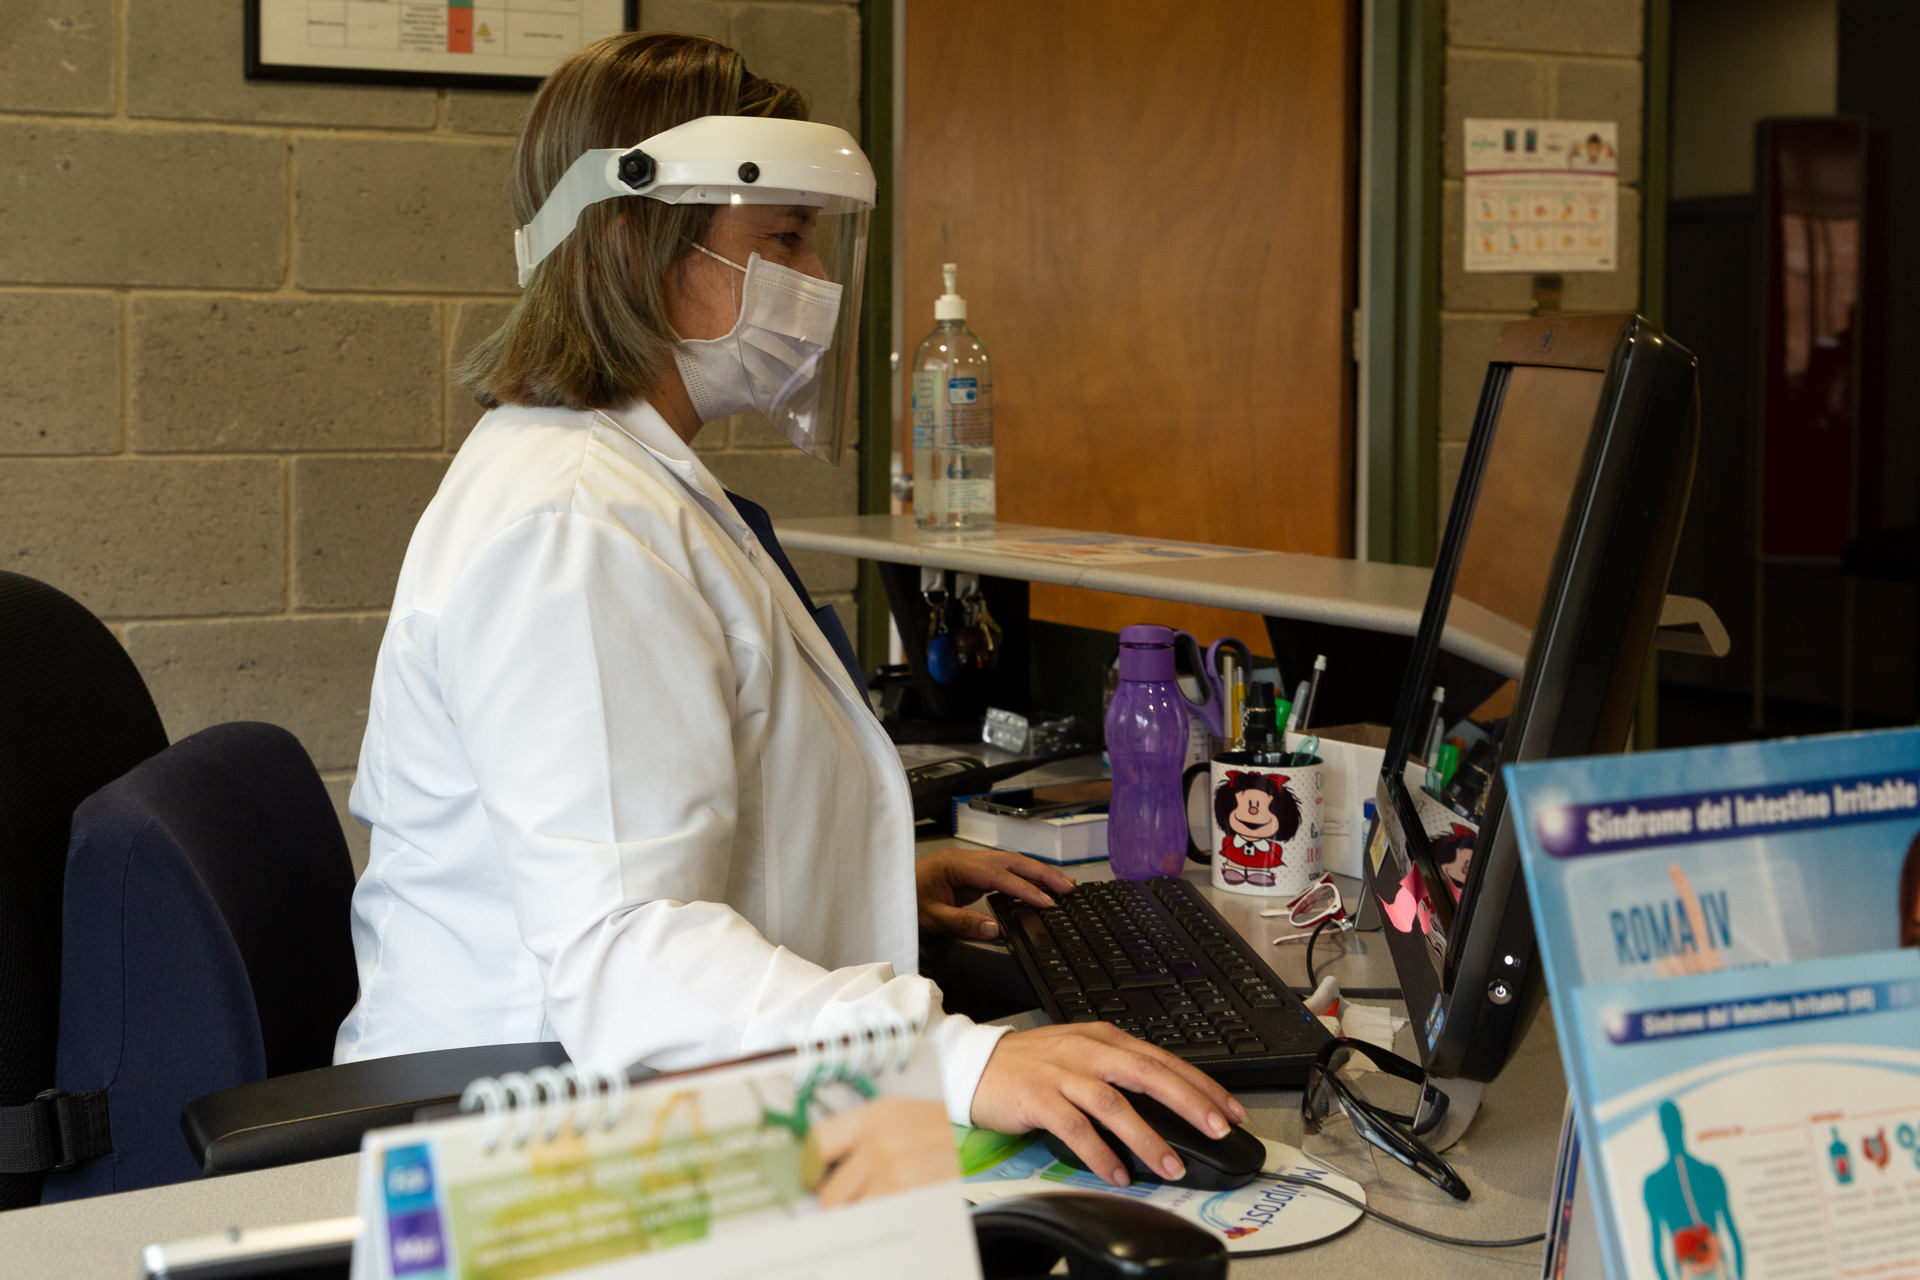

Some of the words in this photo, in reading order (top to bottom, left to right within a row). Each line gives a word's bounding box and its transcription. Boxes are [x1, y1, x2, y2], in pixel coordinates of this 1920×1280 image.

[1696, 796, 1732, 831] del
[1734, 788, 1831, 827] Intestino
[1832, 777, 1917, 815] Irritable
[1610, 898, 1698, 966] ROMA
[1699, 889, 1732, 951] IV
[1239, 1166, 1329, 1227] Mviprost
